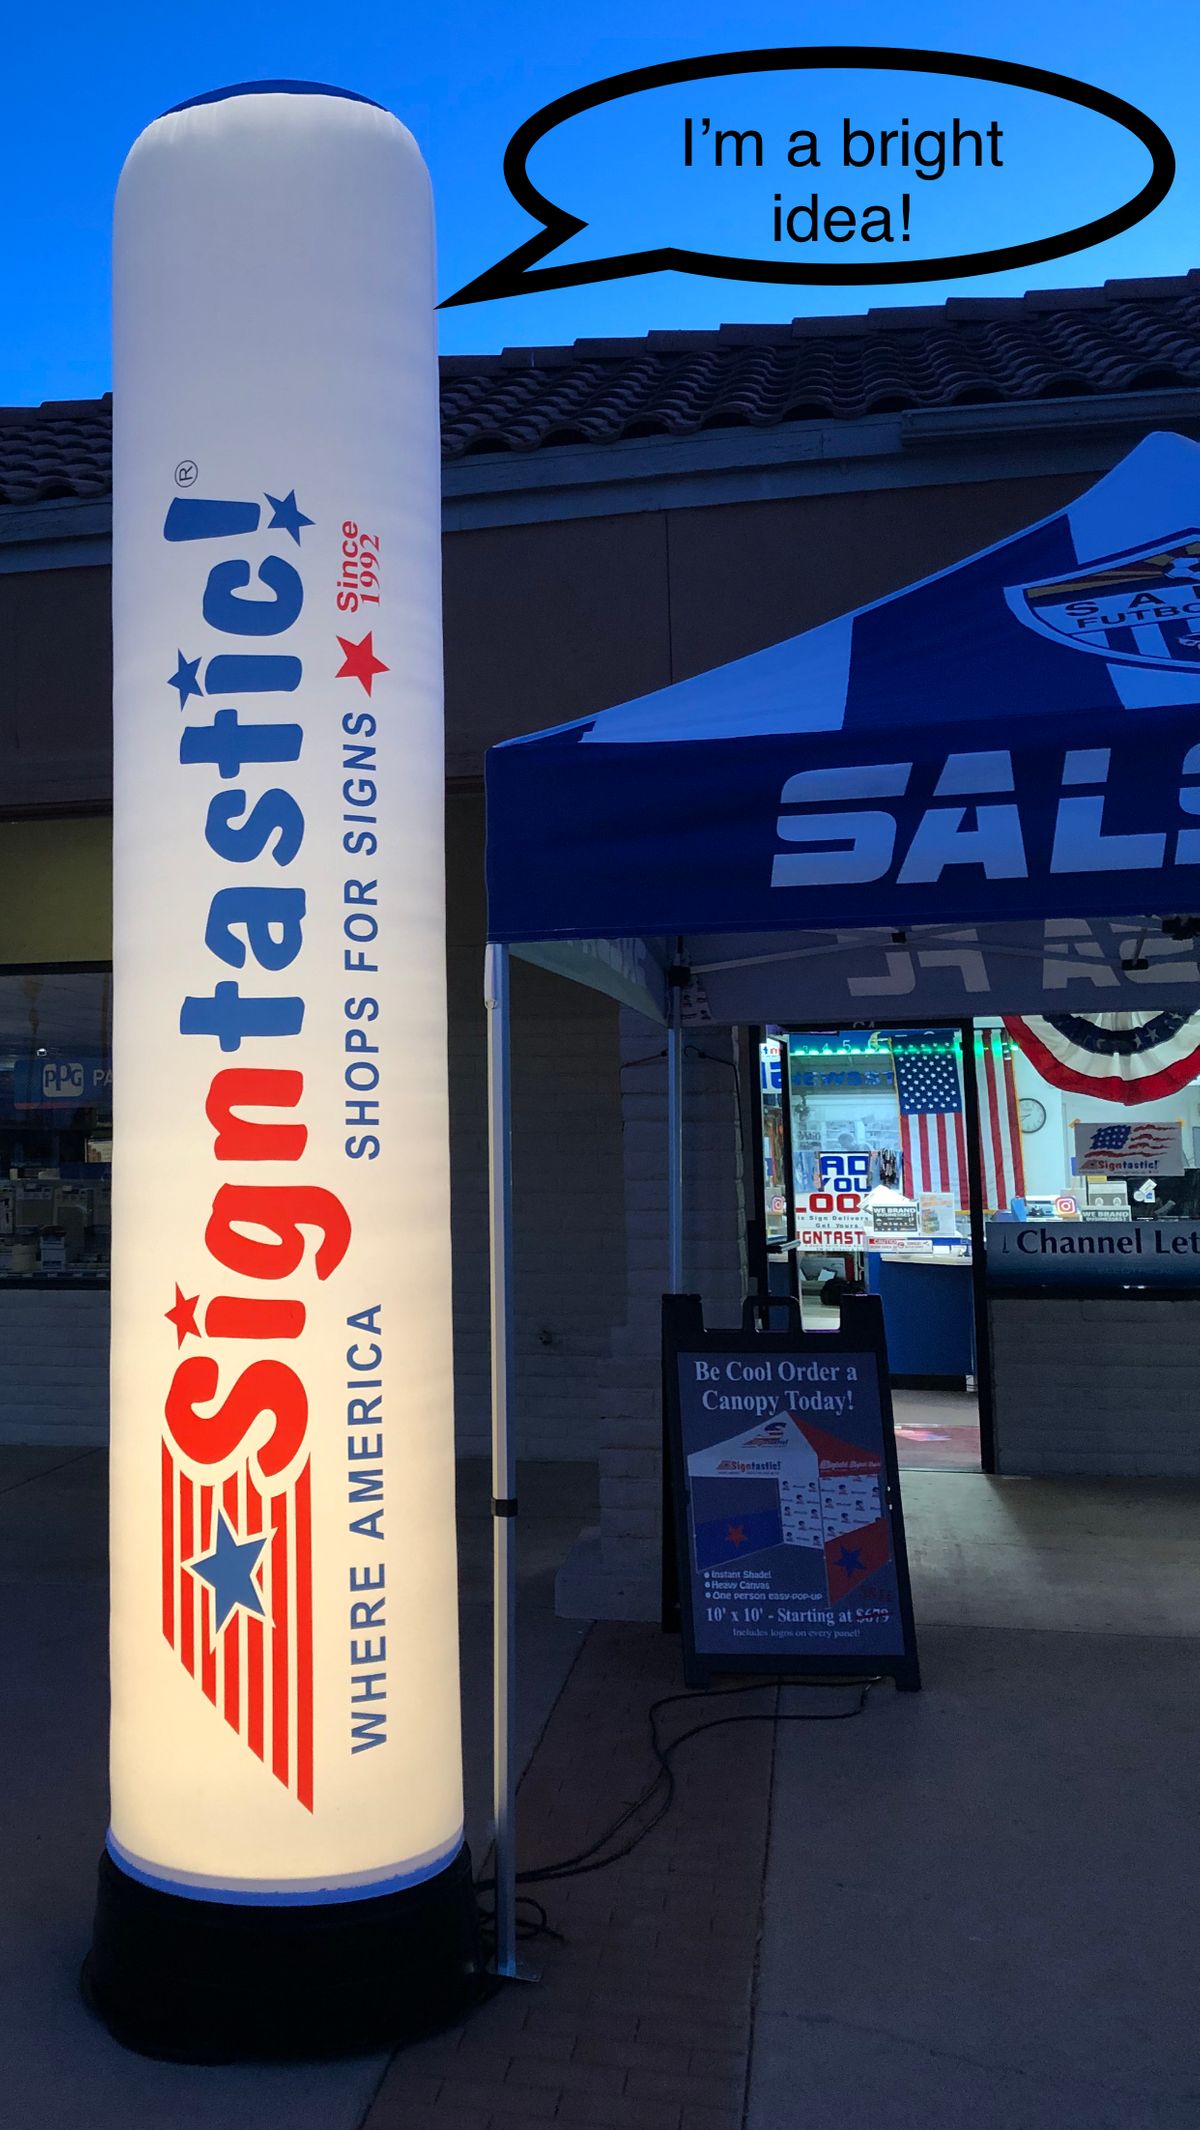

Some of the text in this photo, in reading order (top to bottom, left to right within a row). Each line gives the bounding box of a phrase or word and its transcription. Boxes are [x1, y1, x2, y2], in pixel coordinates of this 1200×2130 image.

[336, 520, 360, 612] Since
[359, 532, 382, 607] 1992
[163, 489, 352, 1478] Signtastic!
[44, 1063, 83, 1092] PPG
[1098, 1159, 1159, 1172] Signtastic!
[1082, 1210, 1129, 1218] WE BRAND
[342, 711, 388, 1755] WHERE AMERICA SHOPS FOR SIGNS
[1016, 1227, 1143, 1254] Channel
[695, 1360, 858, 1382] Be Cool Order a
[702, 1390, 854, 1417] Canopy Today!
[711, 1570, 741, 1579] Instant
[711, 1581, 770, 1591] Heavy Canvas
[712, 1591, 732, 1600] One
[733, 1592, 766, 1602] person
[730, 1611, 740, 1622] x
[777, 1607, 834, 1627] Starting
[838, 1610, 853, 1624] at
[732, 1628, 769, 1637] Includes
